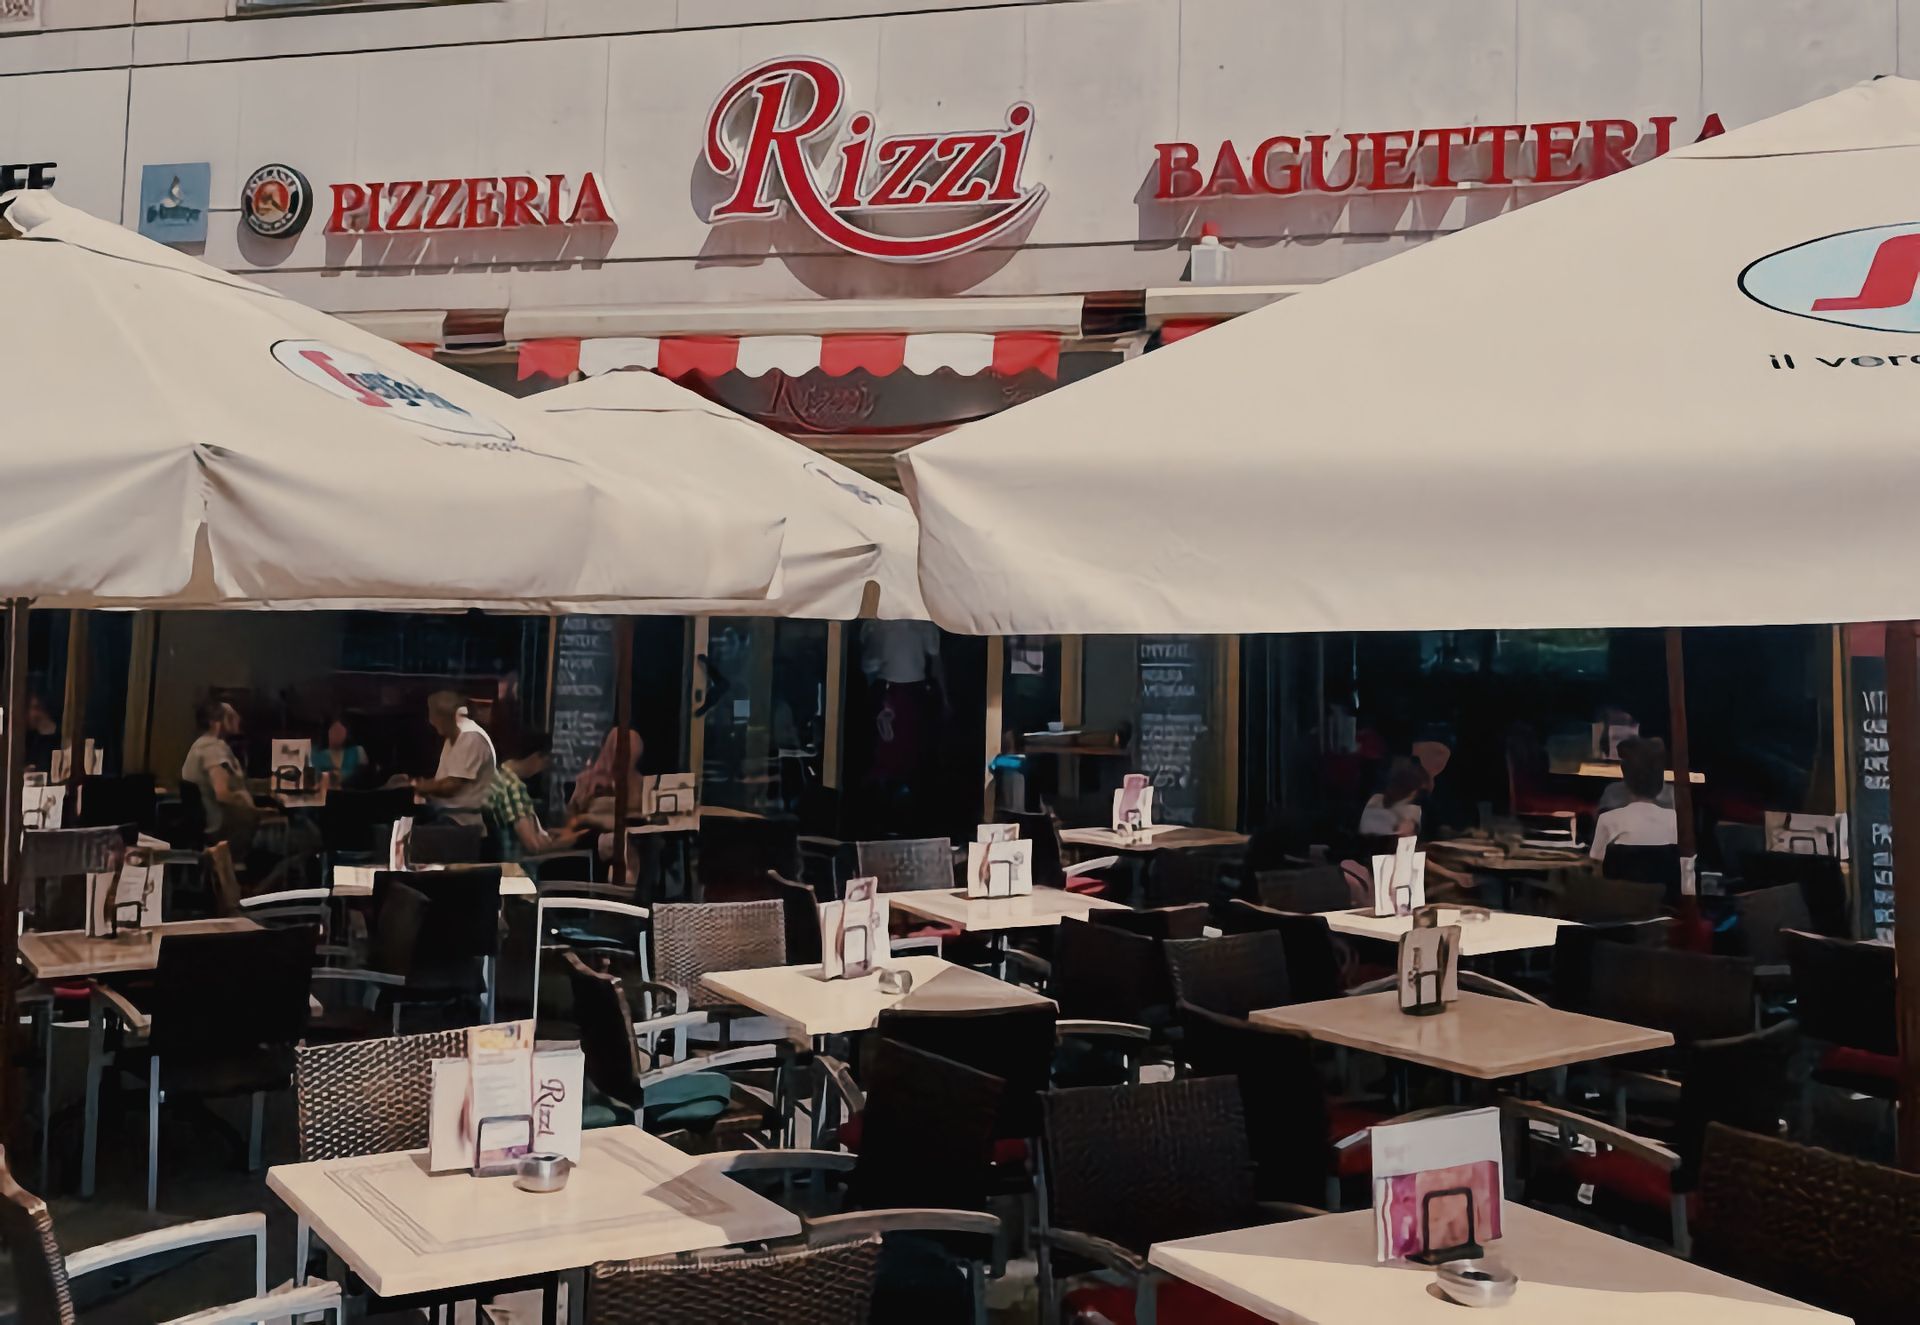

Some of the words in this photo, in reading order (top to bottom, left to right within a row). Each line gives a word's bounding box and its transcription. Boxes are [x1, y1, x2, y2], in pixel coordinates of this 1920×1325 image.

[706, 58, 1046, 261] Rizzi
[1154, 113, 1725, 199] BAGUETTERI
[329, 171, 614, 233] PIZZERIA
[1769, 353, 1795, 370] il
